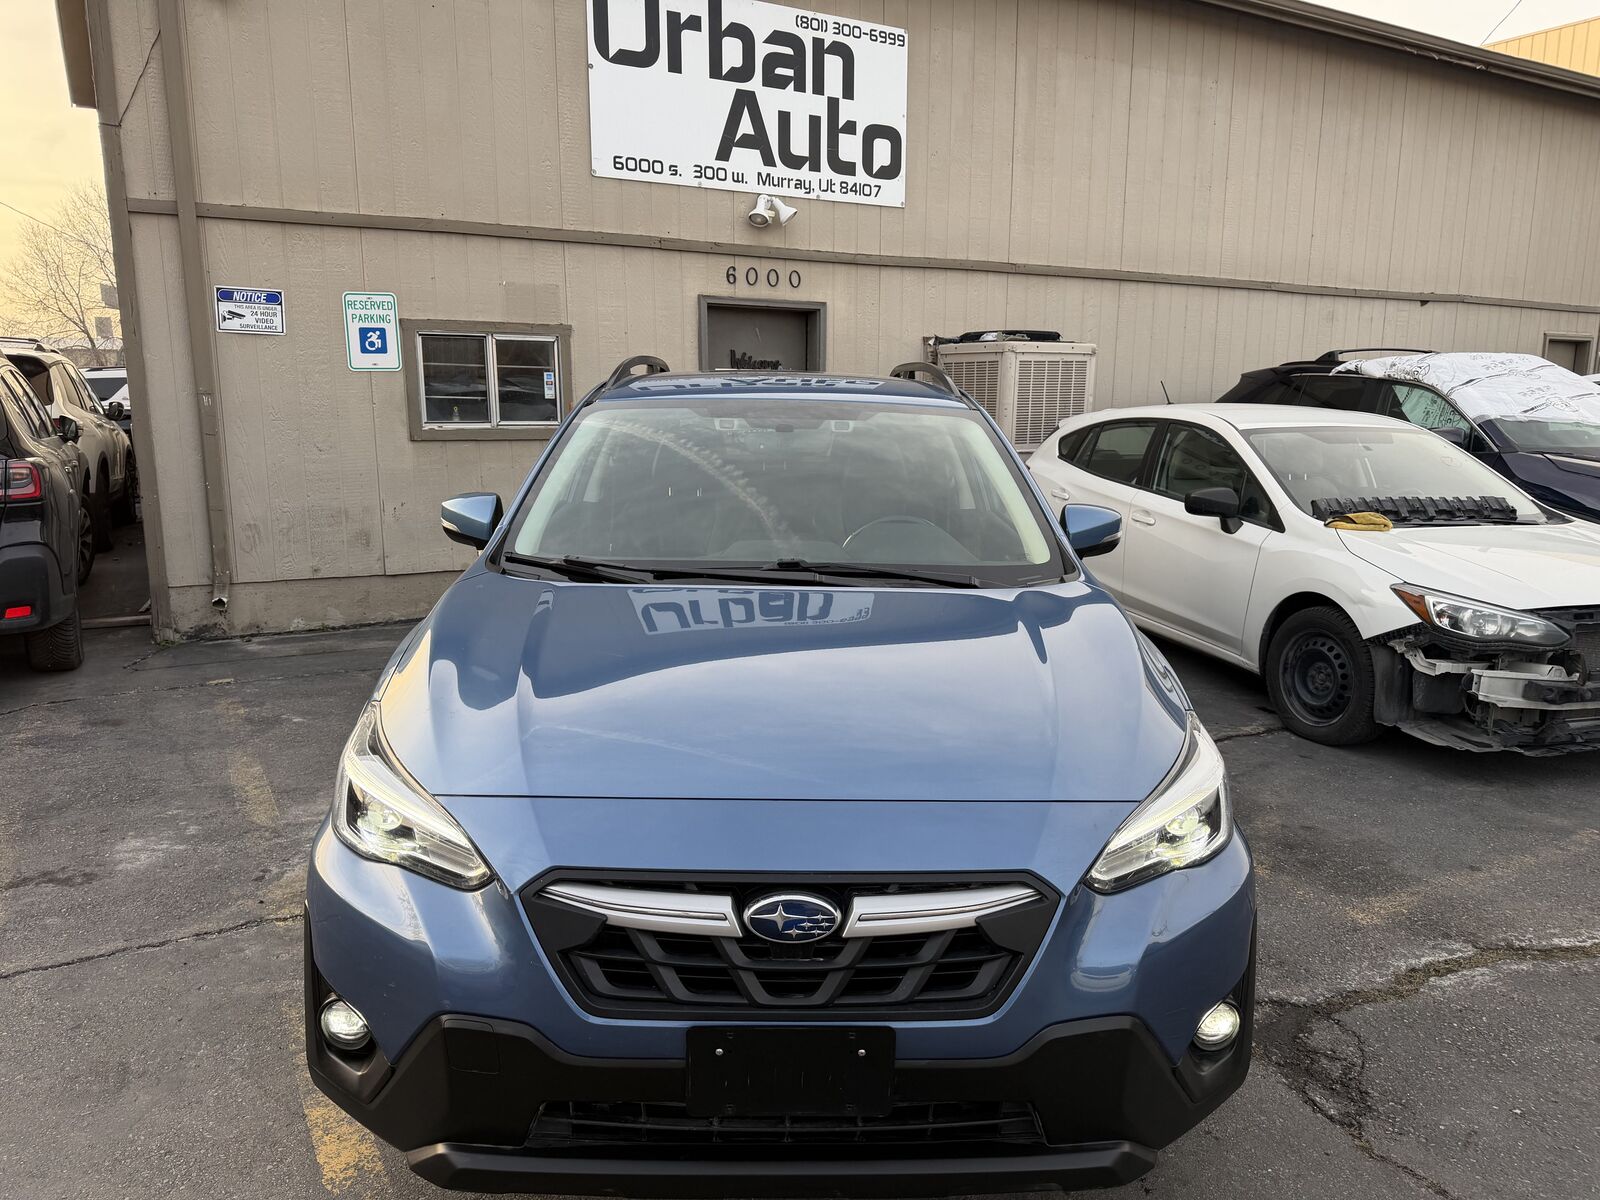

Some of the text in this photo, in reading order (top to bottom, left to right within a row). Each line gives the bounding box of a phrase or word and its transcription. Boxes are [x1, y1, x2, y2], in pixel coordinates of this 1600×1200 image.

[795, 15, 906, 47] (801) 300-6999
[594, 0, 854, 100] Urban
[715, 88, 902, 180] Auto
[613, 155, 664, 174] 6000
[693, 164, 728, 182] 300
[757, 172, 816, 194] Murray,
[818, 180, 836, 193] Ut
[840, 181, 882, 198] 84107
[726, 266, 801, 288] 6000
[233, 291, 267, 303] NOTICE
[347, 300, 393, 311] RESERVED
[351, 313, 391, 324] PARKING
